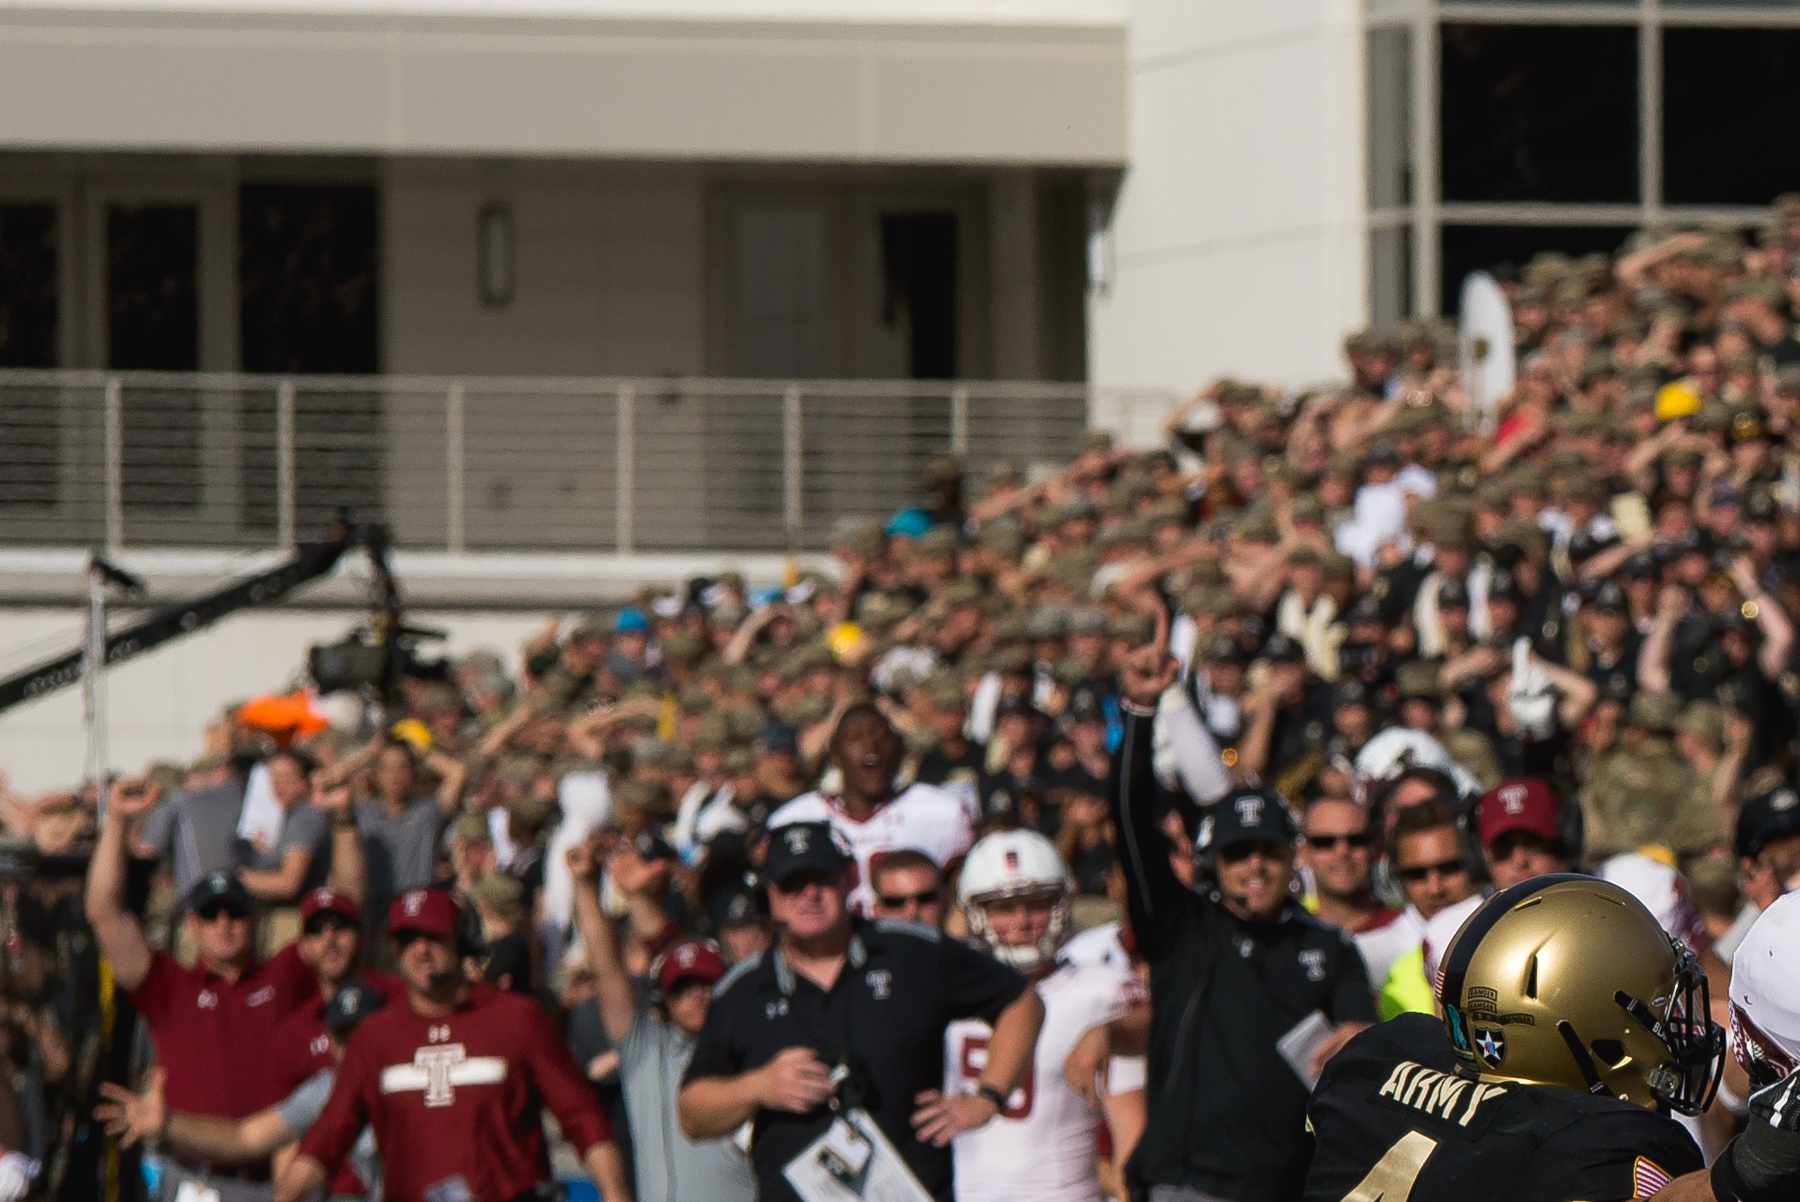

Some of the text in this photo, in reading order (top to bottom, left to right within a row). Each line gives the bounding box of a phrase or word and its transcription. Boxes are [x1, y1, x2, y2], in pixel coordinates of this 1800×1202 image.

[1235, 796, 1265, 827] T
[1498, 784, 1528, 815] T
[784, 827, 812, 854] T
[1299, 949, 1326, 981] T
[867, 969, 892, 999] T
[414, 1042, 467, 1109] T
[1379, 1061, 1508, 1127] ARMY
